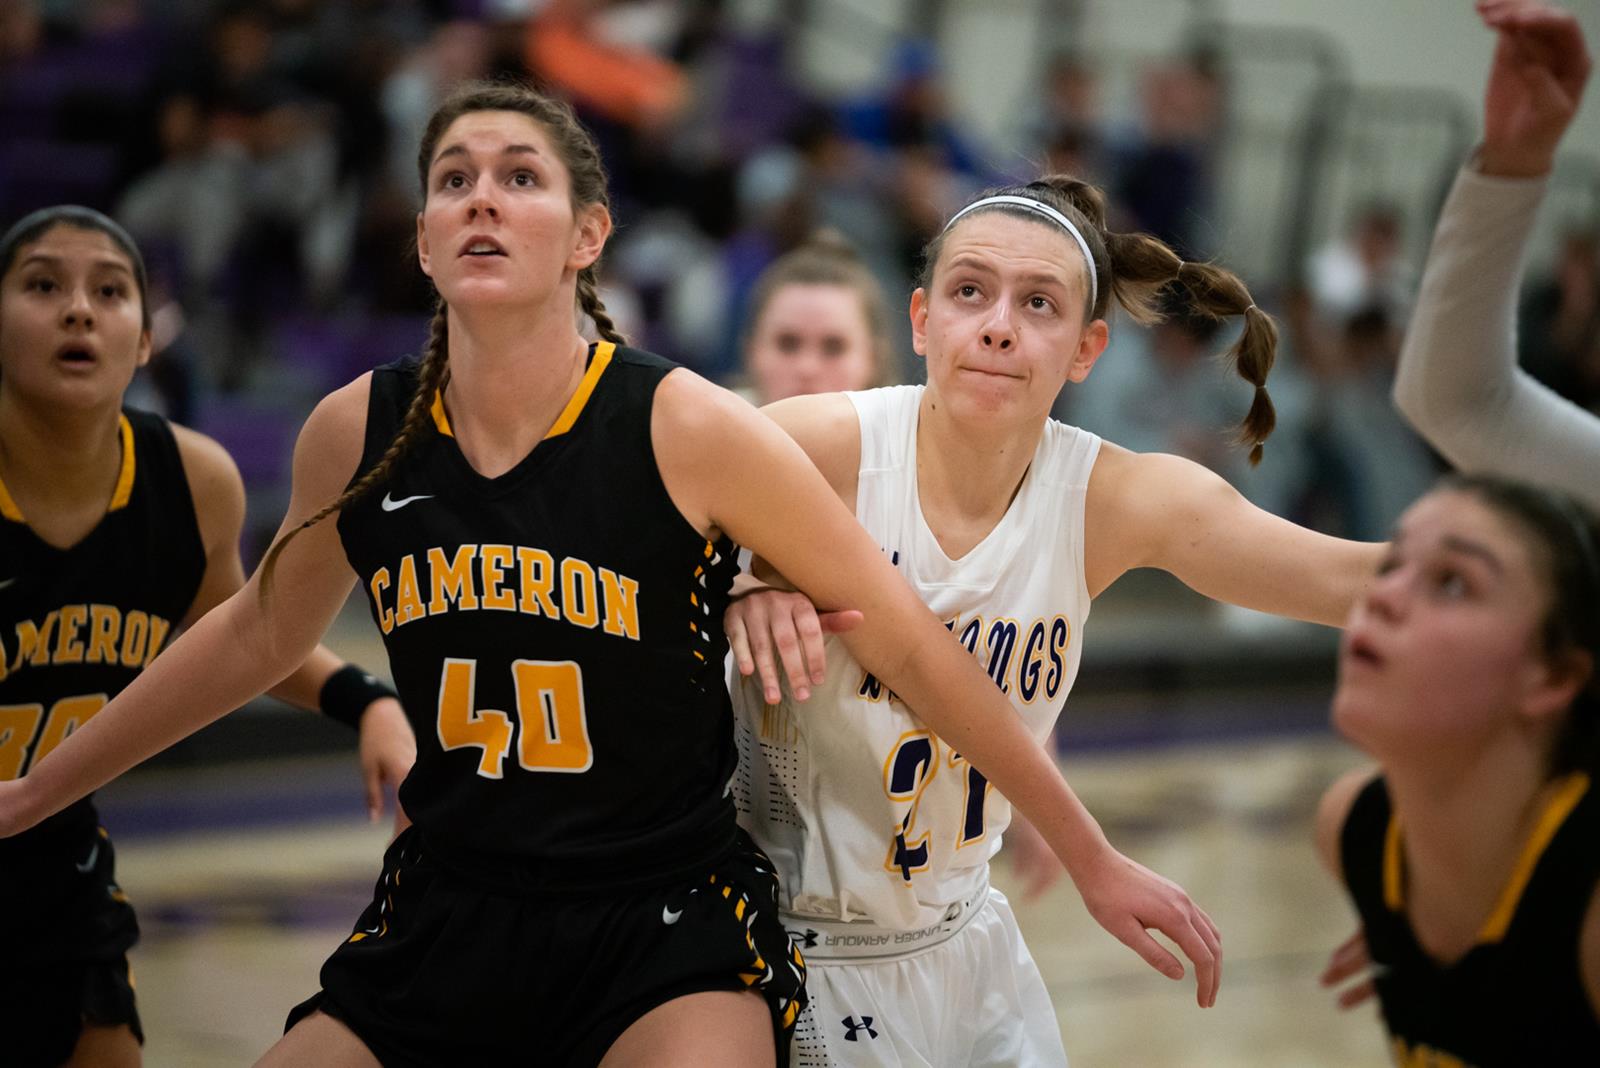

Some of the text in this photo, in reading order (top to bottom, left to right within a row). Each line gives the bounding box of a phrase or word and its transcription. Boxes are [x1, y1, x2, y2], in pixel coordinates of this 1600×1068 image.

[370, 544, 641, 641] CAMERON
[437, 657, 593, 779] 40
[824, 925, 942, 947] UNDER ARMOUR
